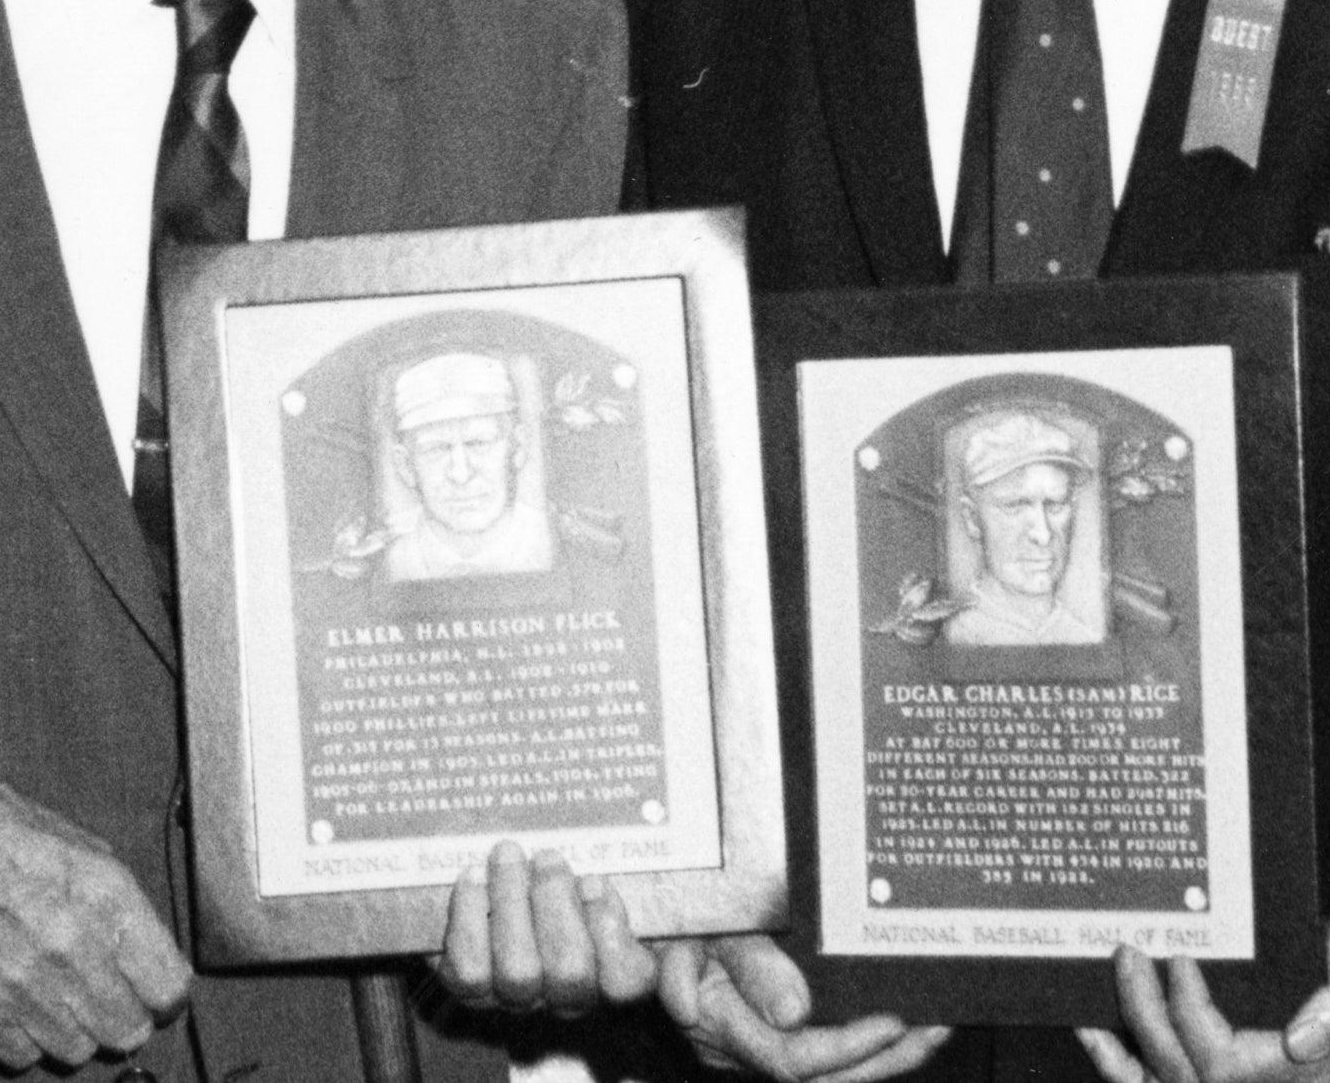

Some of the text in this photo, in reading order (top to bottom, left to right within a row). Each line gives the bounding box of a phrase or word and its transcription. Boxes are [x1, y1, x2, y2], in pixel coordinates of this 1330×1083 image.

[1212, 16, 1271, 51] GUEST
[327, 610, 621, 647] ELMER HARRISON FLICK
[443, 690, 484, 705] WHO
[883, 683, 1181, 704] EDGAR CHARLES (SAM) RICE
[900, 705, 1018, 719] WASHINGTON,
[1102, 706, 1123, 719] TO
[934, 721, 1085, 735] CLEVELAND, A.L.
[885, 736, 1181, 750] AT BAT 600 OR MORE TIMES EIGHT
[866, 752, 956, 764] DIFFERENT
[1099, 753, 1119, 765] OR
[1123, 753, 1165, 765] MORE
[310, 759, 403, 777] CHAMPION
[878, 767, 1001, 781] IN EACH OF SIX
[972, 785, 1039, 798] CAREER
[1045, 785, 1080, 798] AND
[1085, 786, 1122, 799] HAD
[878, 801, 907, 813] SET
[943, 801, 1009, 814] RECORD
[1013, 802, 1057, 814] WITH
[1093, 802, 1165, 815] SINGLES
[1171, 803, 1191, 815] IN
[922, 818, 953, 831] LED
[989, 818, 1008, 831] IN
[1014, 819, 1086, 832] NUMBER
[1092, 819, 1112, 832] OF
[1118, 819, 1158, 833] HITS
[874, 836, 894, 848] IN
[943, 836, 979, 849] AND
[1031, 837, 1062, 850] LED
[1101, 837, 1119, 850] IN
[1125, 838, 1198, 851] PUTOUTS
[303, 855, 399, 877] NATIONAL
[902, 852, 1014, 866] OUTFIELDERS
[1019, 853, 1063, 867] WITH
[1102, 854, 1122, 867] IN
[1168, 855, 1207, 868] AND
[1021, 870, 1042, 883] IN
[862, 924, 1212, 948] NATIONAL BASEBALL HALL OF FAME
